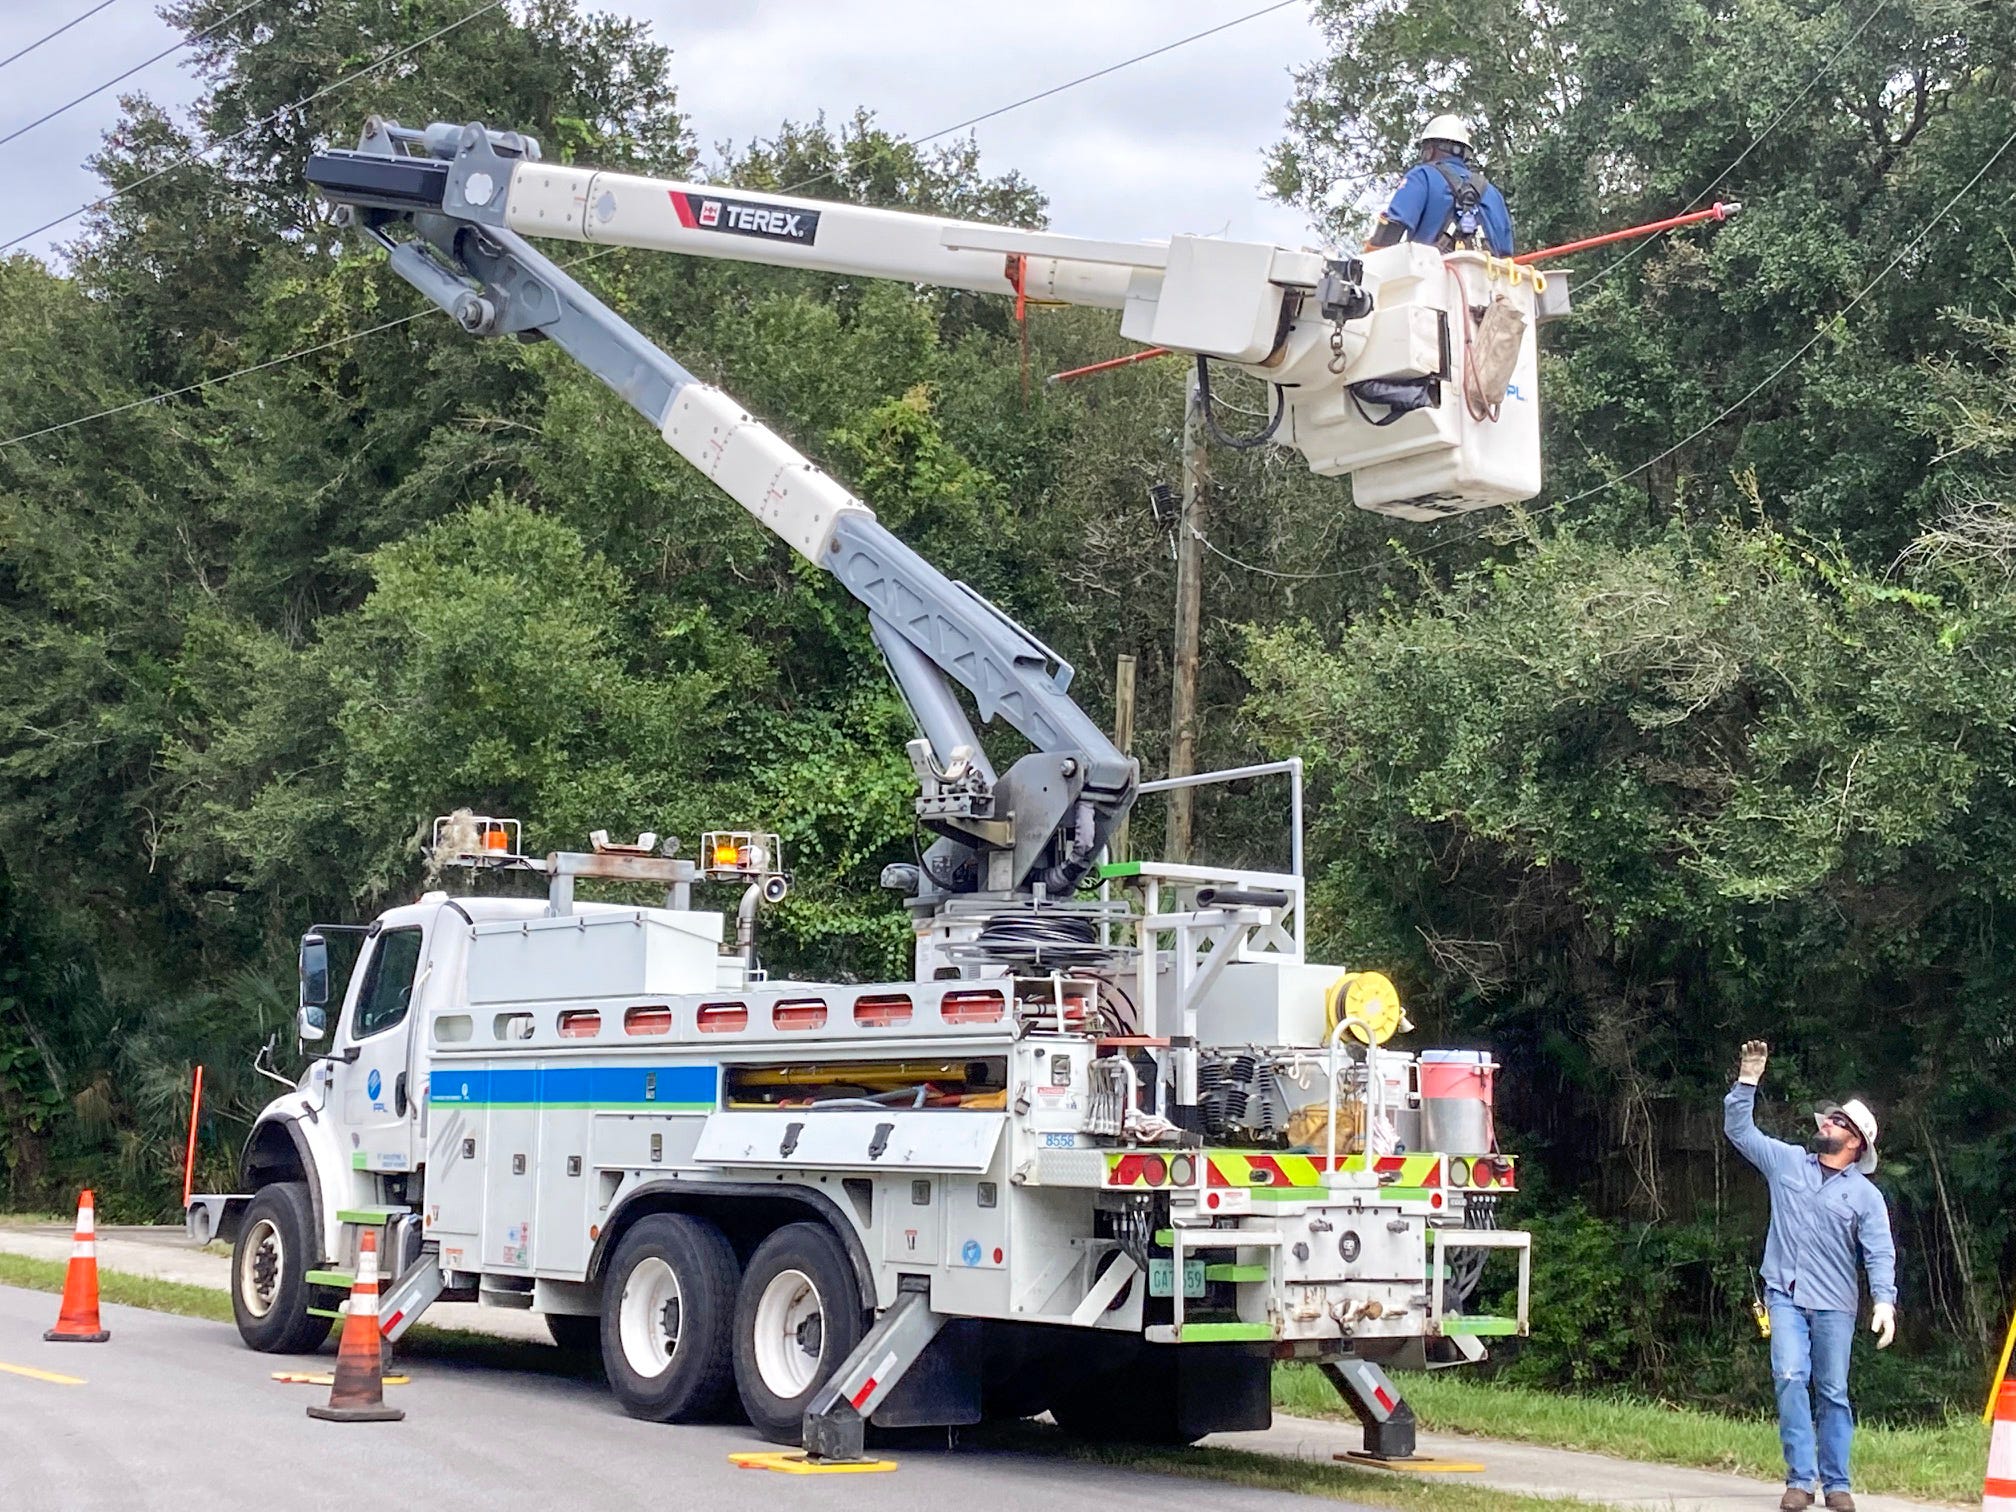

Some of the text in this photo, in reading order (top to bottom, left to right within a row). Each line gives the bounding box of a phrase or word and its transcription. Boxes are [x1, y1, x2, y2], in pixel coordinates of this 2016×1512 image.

[726, 204, 803, 237] TEREX
[1506, 384, 1526, 402] PL
[1046, 1133, 1075, 1147] 8558
